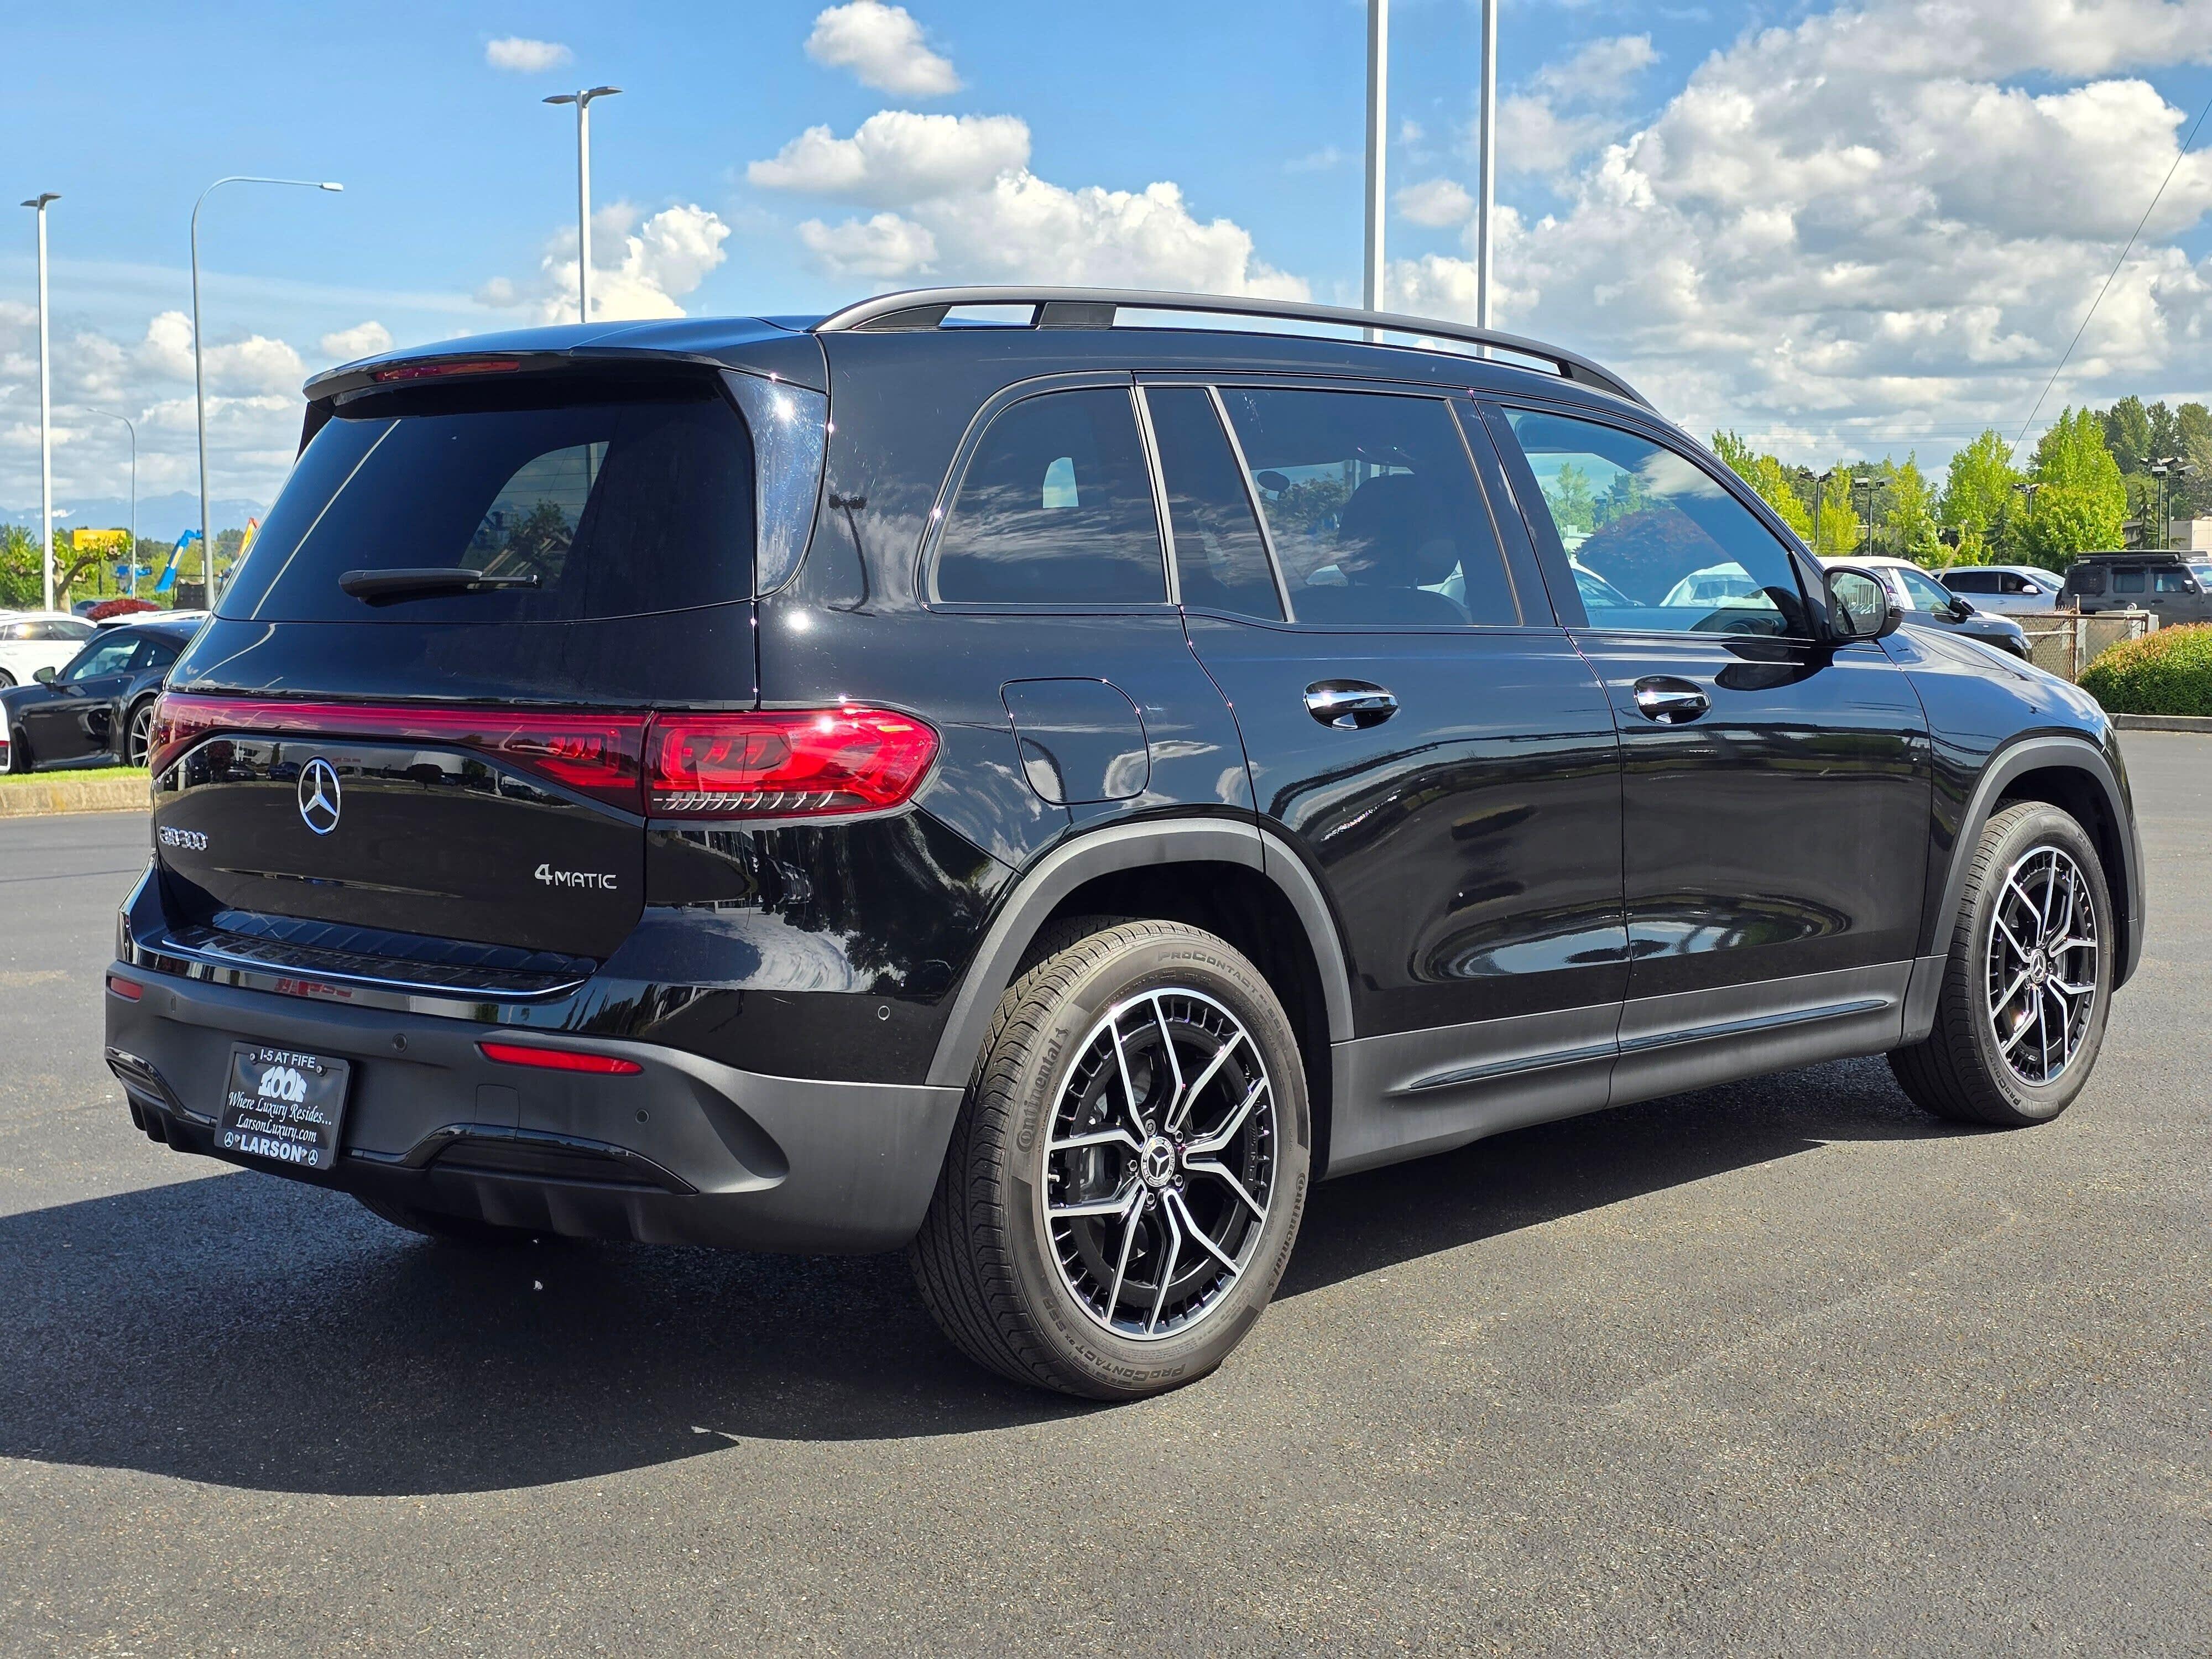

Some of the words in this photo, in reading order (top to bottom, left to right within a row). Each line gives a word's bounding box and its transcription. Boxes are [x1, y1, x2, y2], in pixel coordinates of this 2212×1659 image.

[534, 864, 617, 889] 4MATIC
[260, 1048, 273, 1060] I-5
[274, 1051, 290, 1063] AT
[291, 1054, 316, 1068] FIFE
[228, 1091, 254, 1110] Where
[255, 1098, 288, 1122] Luxury
[236, 1114, 317, 1142] LarsonLuxury.com
[240, 1134, 302, 1162] LARSON
